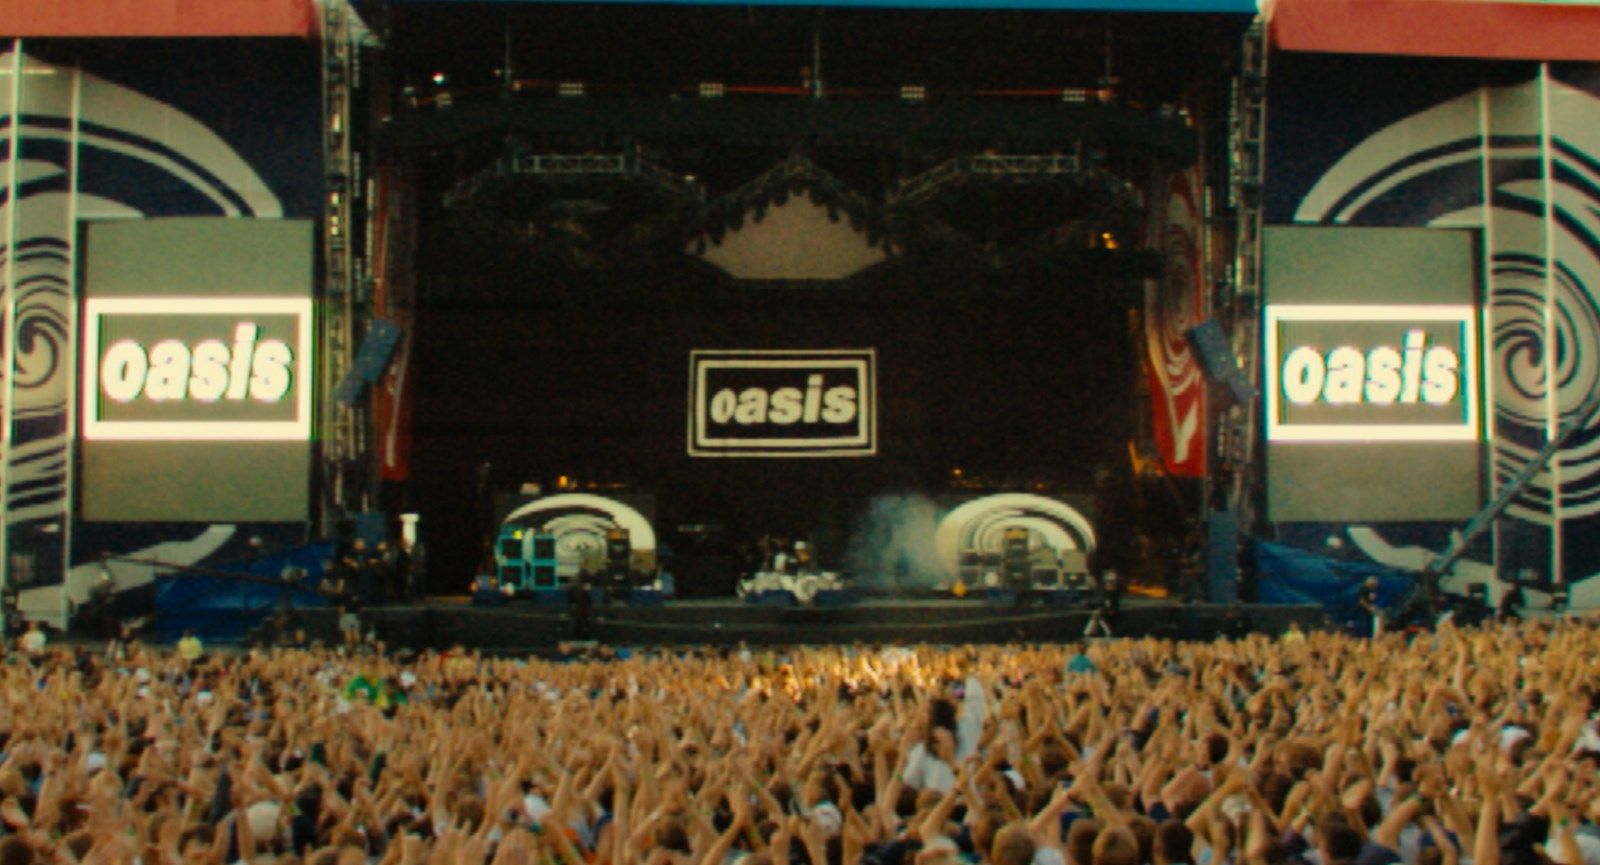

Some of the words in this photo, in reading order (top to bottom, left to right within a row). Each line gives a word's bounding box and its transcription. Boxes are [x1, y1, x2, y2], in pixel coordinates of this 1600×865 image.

[102, 322, 292, 402] oasis
[711, 374, 856, 425] oasis
[1282, 328, 1459, 405] oasis
